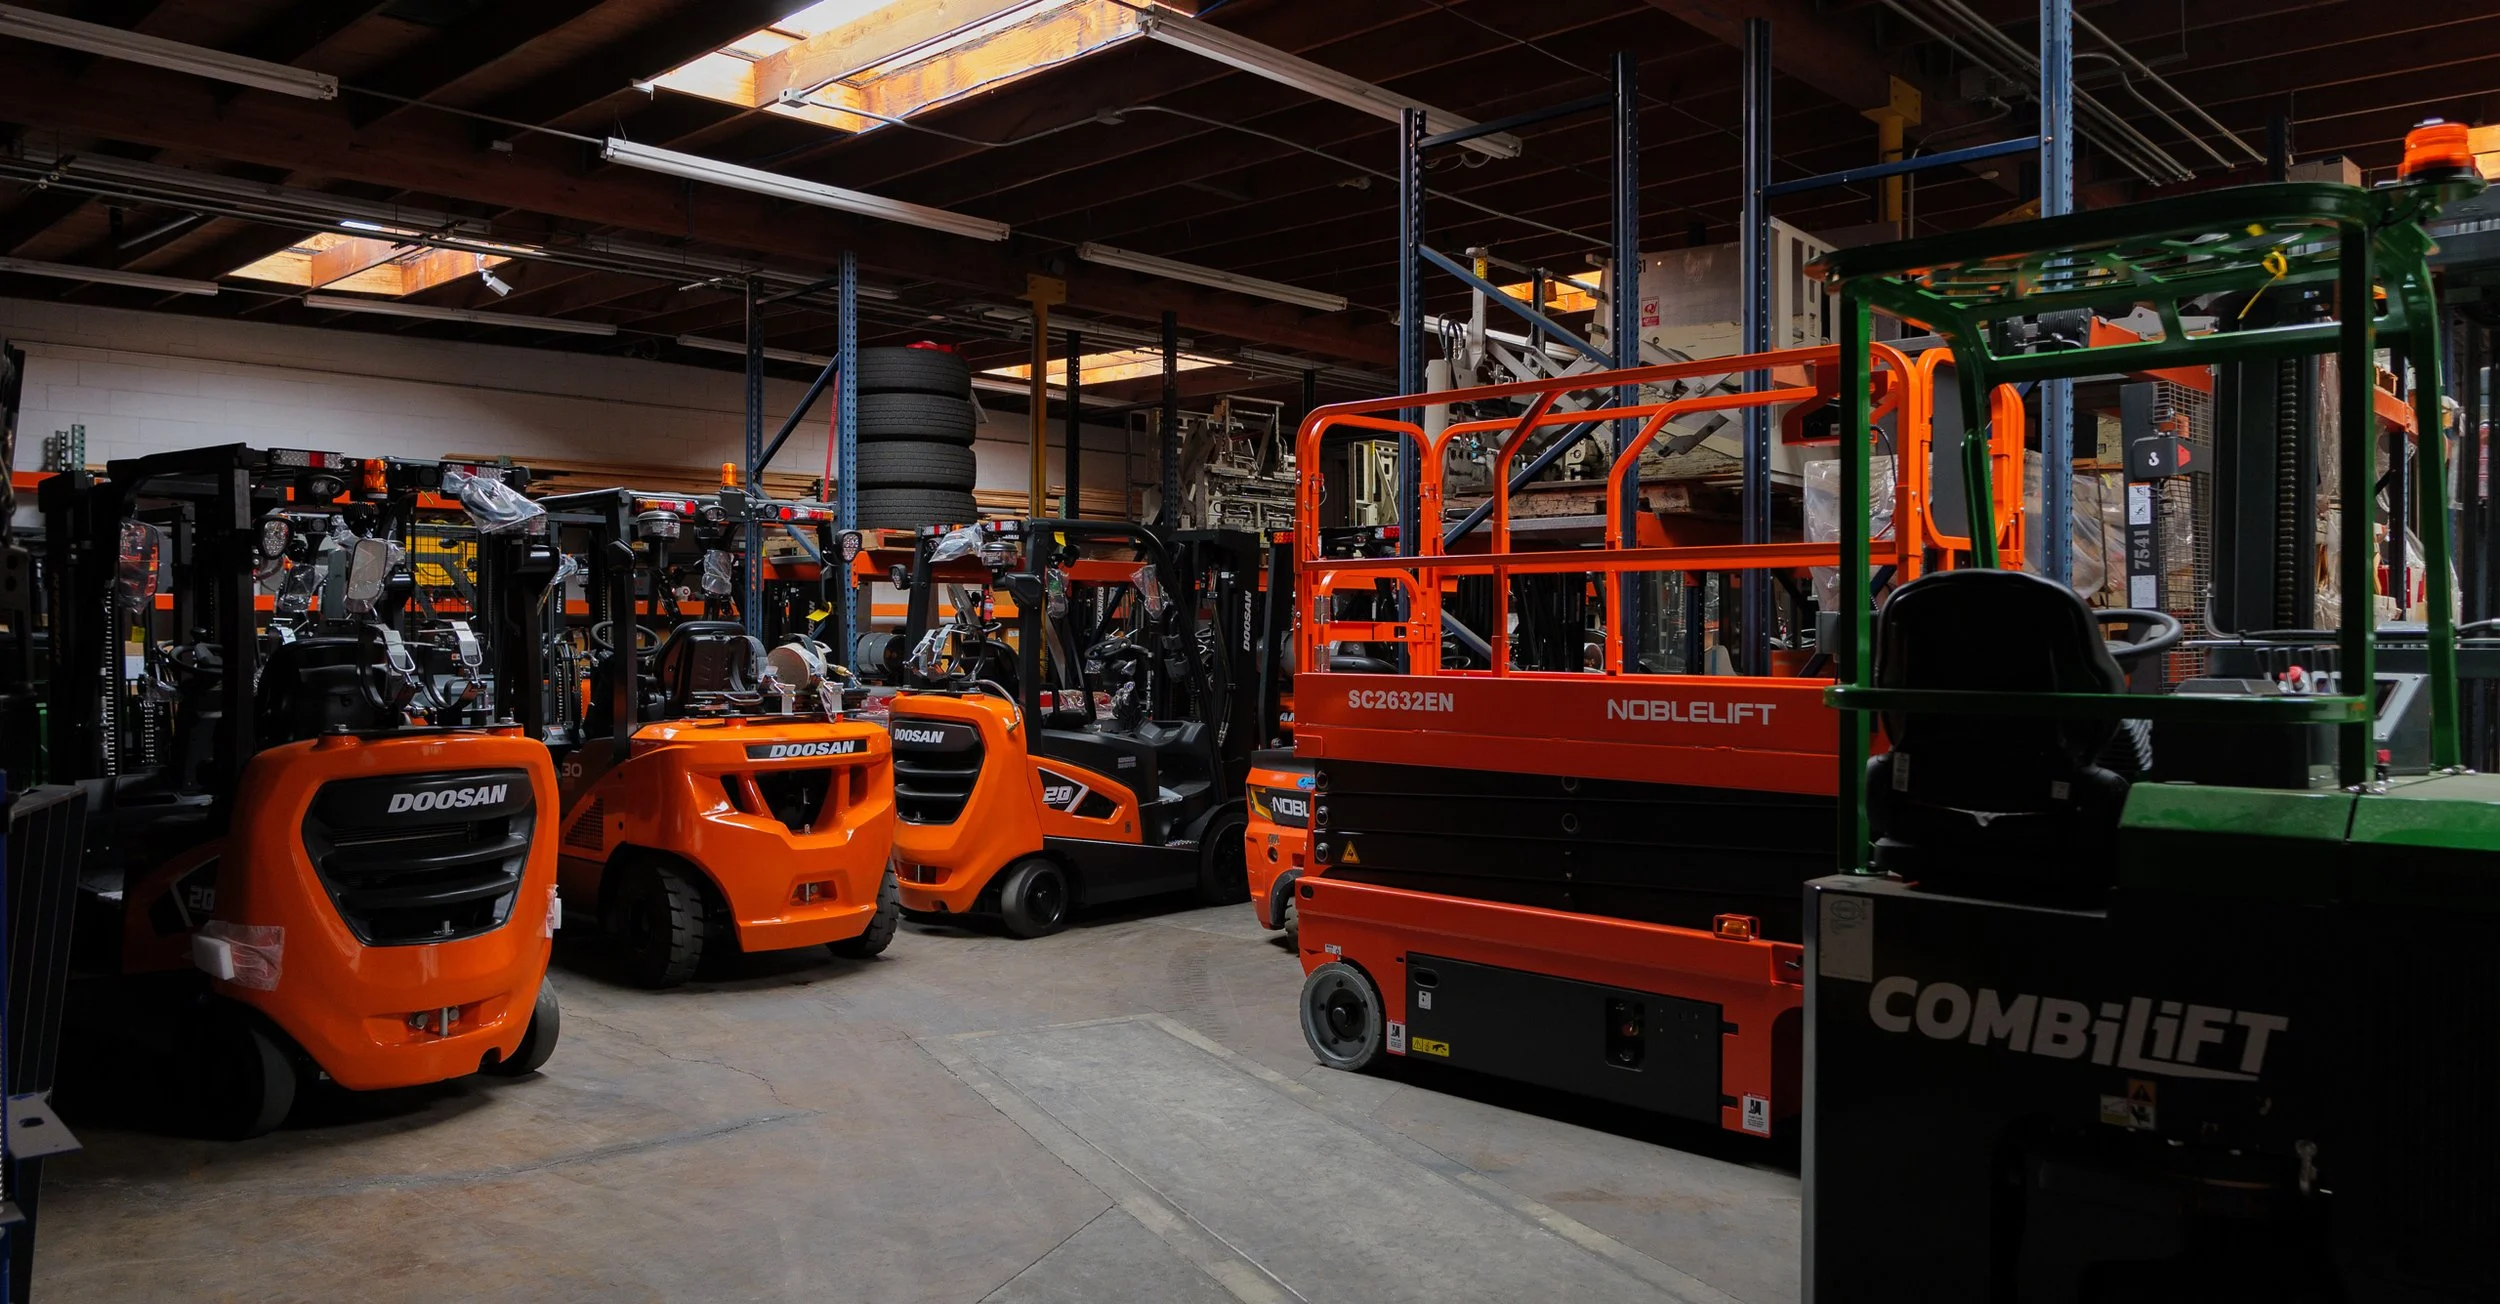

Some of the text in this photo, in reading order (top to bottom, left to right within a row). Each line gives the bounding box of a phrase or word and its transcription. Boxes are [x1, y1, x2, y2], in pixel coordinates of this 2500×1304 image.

[2133, 529, 2151, 570] 7541
[1243, 590, 1252, 652] DOOSAN
[1348, 690, 1454, 712] SC2632EN
[1607, 699, 1776, 726] NOBLELIFT
[894, 728, 945, 743] DOOSAN
[769, 740, 855, 758] DOOSAN
[562, 763, 582, 778] 30
[387, 784, 508, 813] DOOSAN
[1042, 785, 1074, 804] 20
[1272, 796, 1310, 818] NOBL
